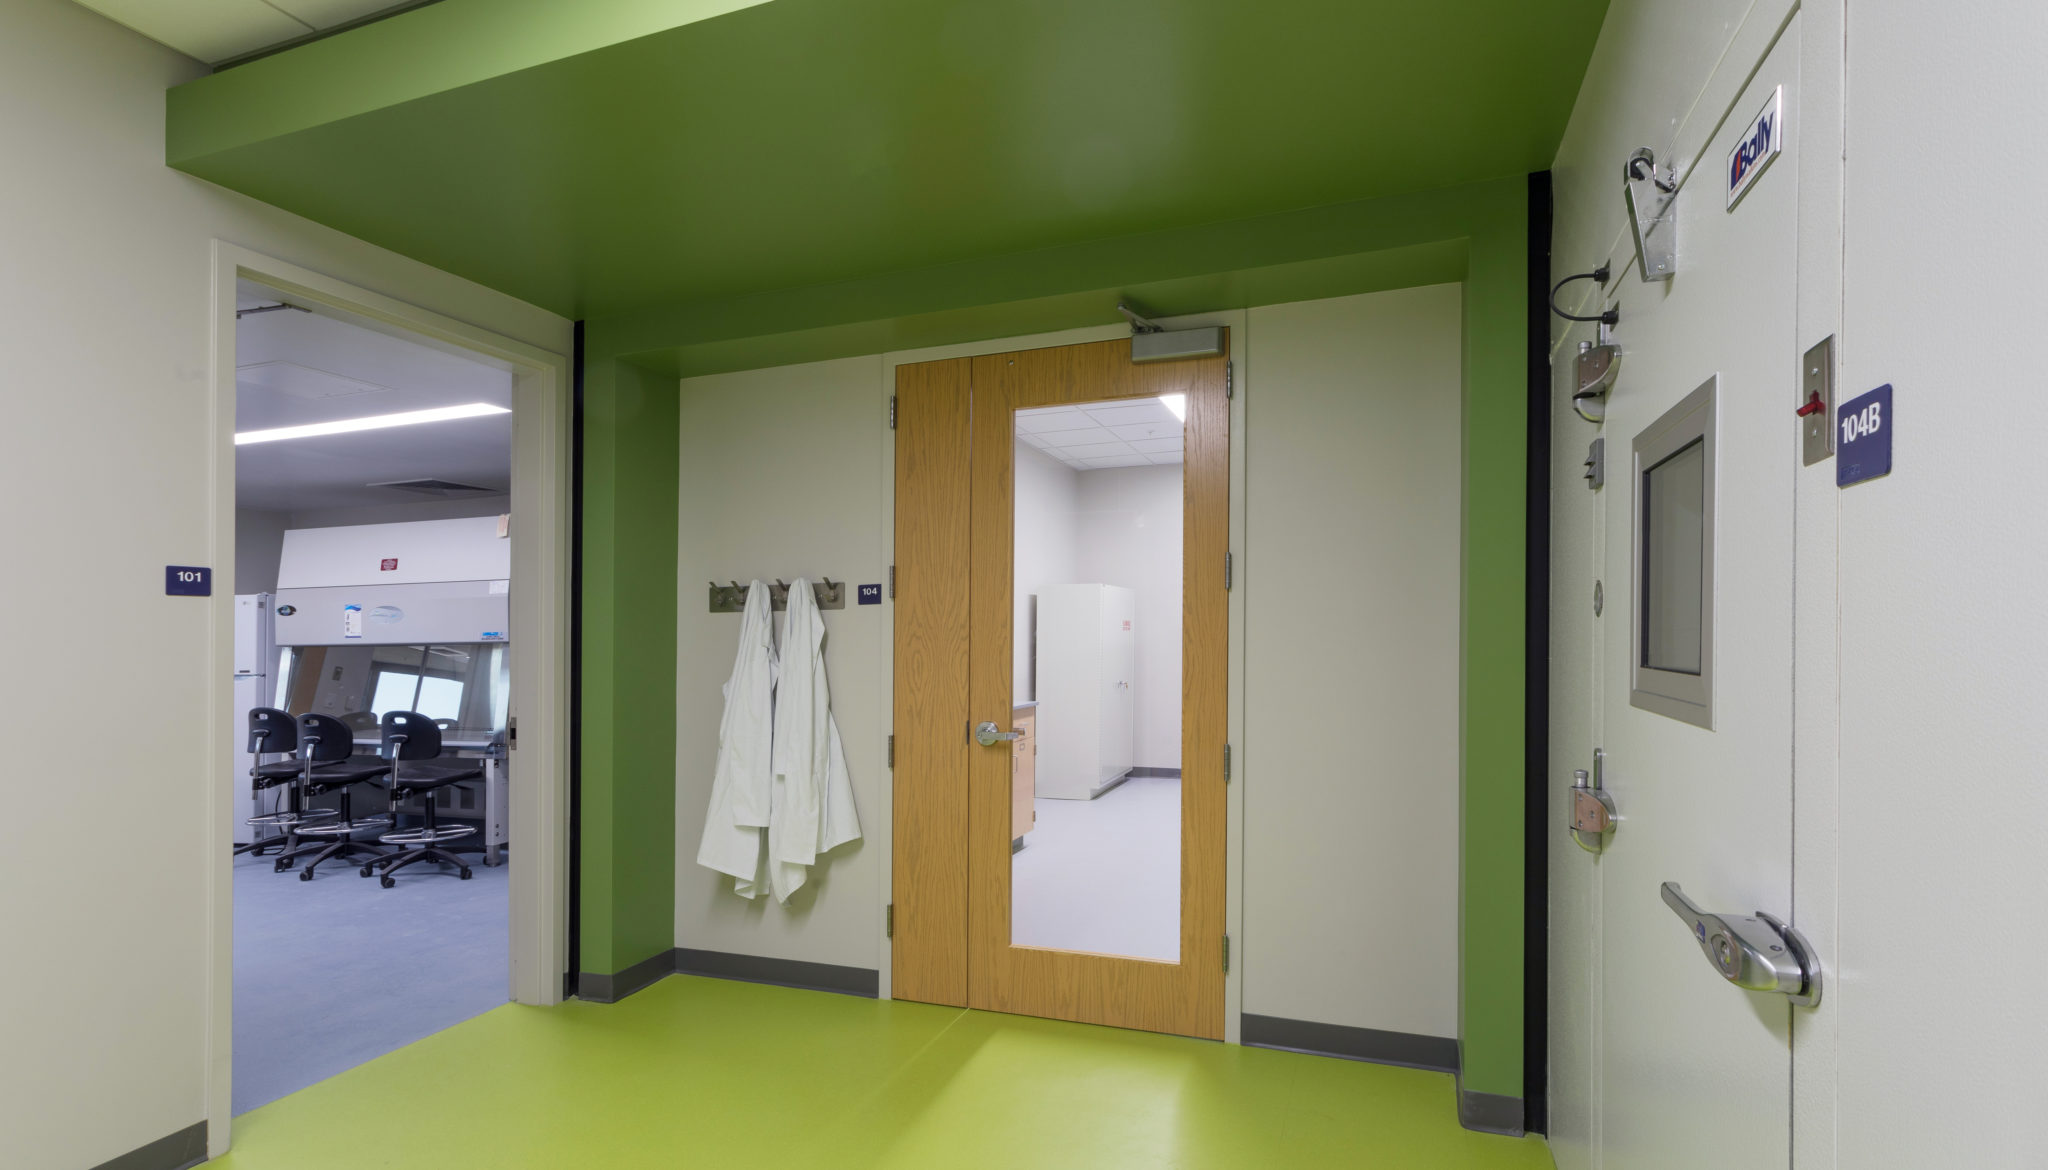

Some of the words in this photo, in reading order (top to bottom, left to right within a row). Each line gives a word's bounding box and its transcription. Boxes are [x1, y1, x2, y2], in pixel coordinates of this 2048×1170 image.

[1731, 112, 1773, 190] Bally
[1841, 402, 1880, 444] 104B
[177, 571, 201, 582] 101
[862, 587, 877, 596] 104
